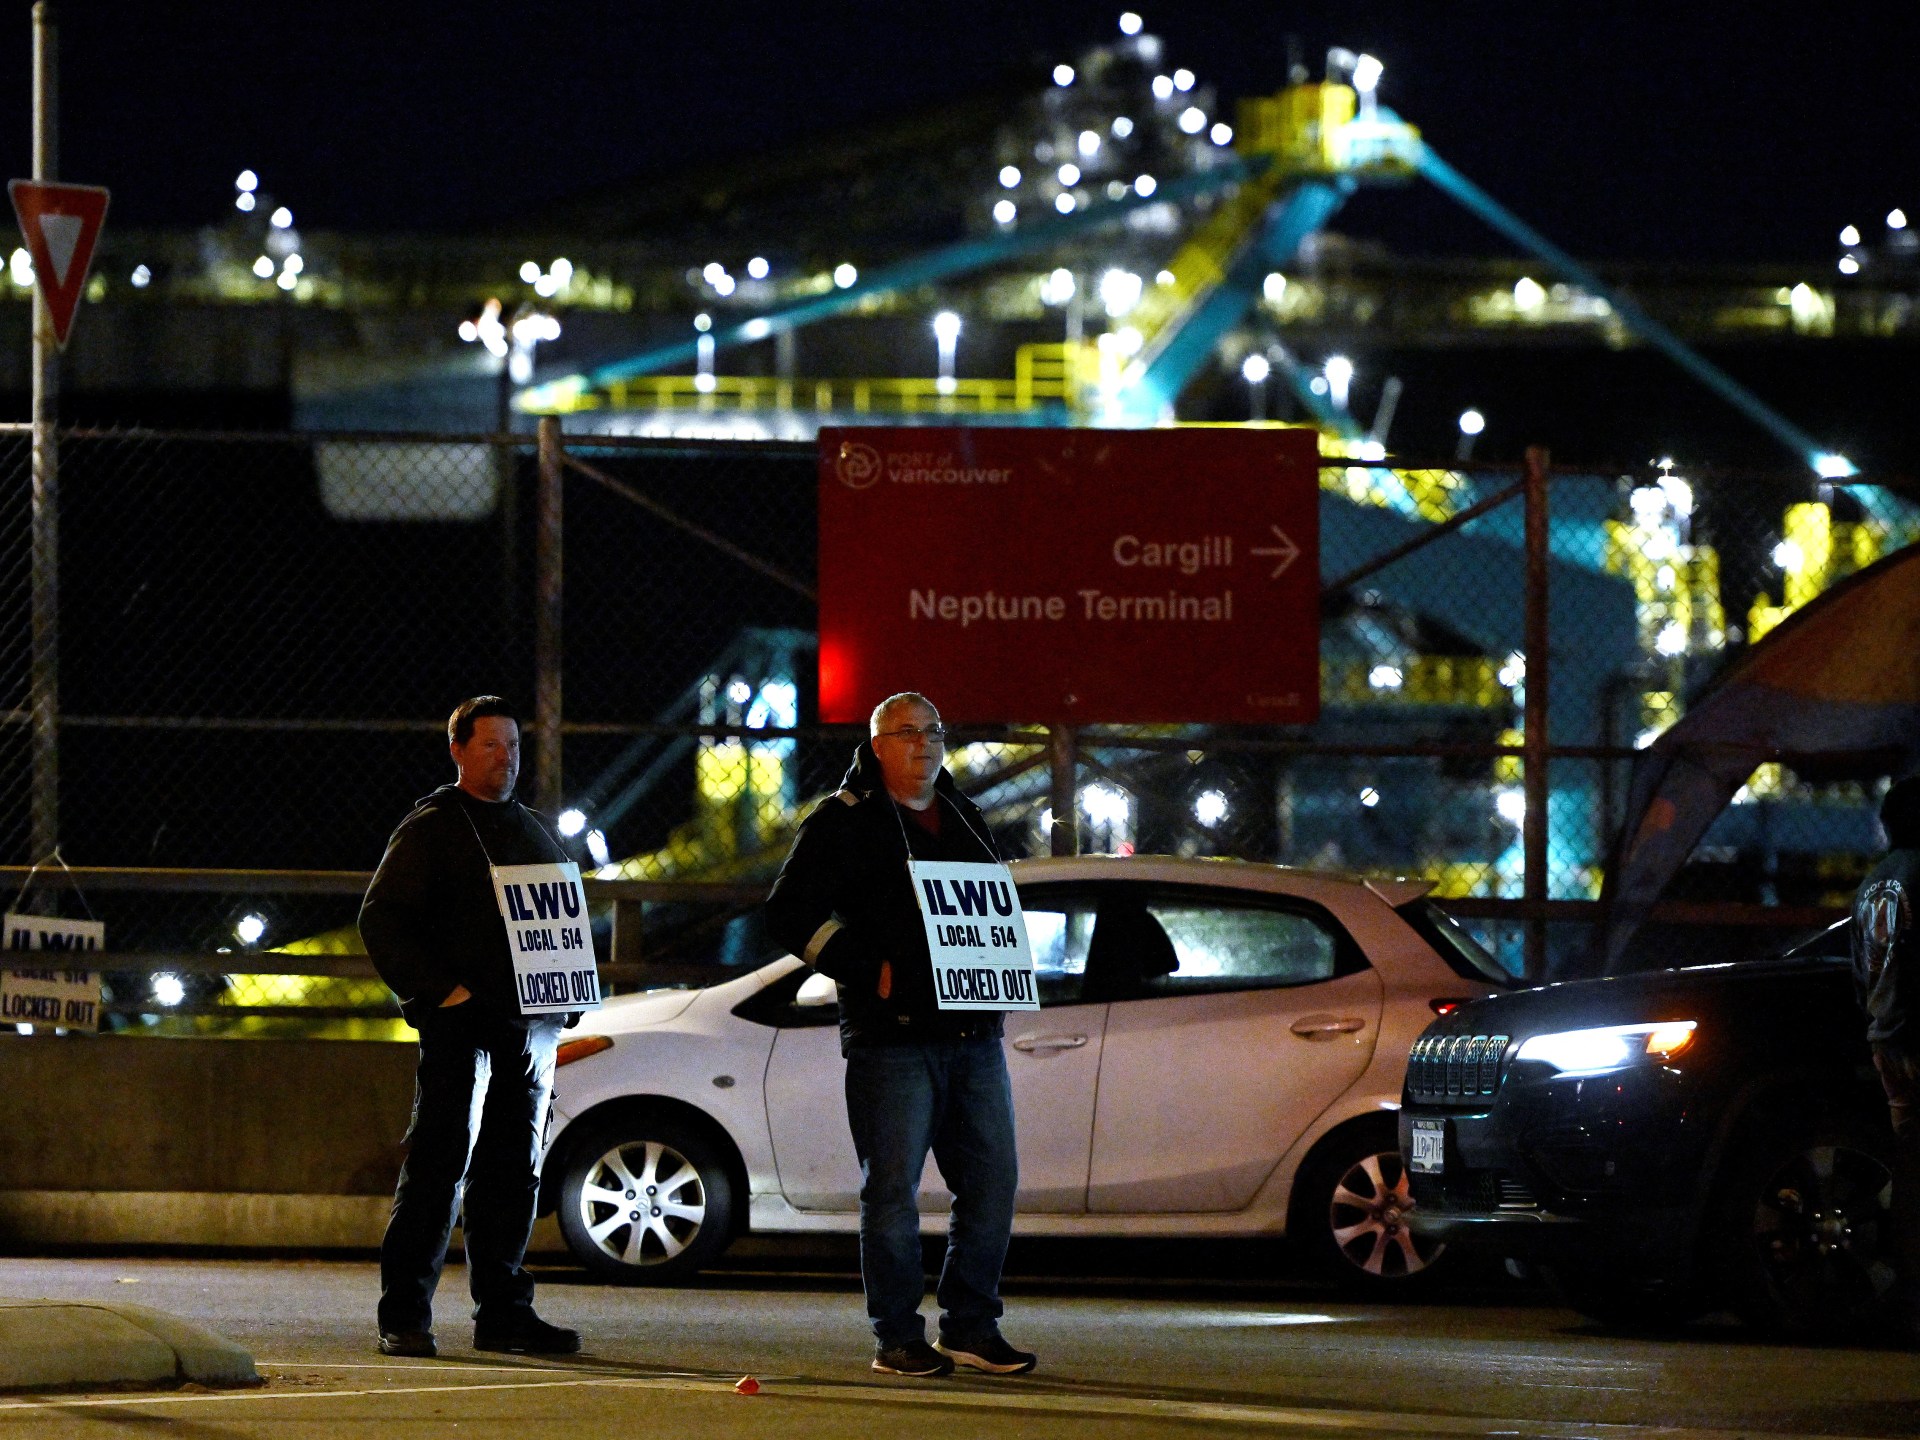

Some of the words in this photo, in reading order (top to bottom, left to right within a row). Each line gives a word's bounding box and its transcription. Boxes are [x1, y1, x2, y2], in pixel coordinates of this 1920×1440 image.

[887, 468, 1013, 484] vancouver
[1112, 533, 1233, 576] Cargill
[908, 588, 1067, 629] Neptune
[1077, 589, 1233, 622] Terminal
[504, 882, 579, 921] ILWU
[922, 879, 1013, 917] ILWU
[517, 929, 557, 951] LOCAL
[561, 927, 583, 950] 514
[937, 924, 987, 948] LOCAL
[990, 925, 1018, 949] 514
[518, 971, 569, 1004] LOCKED
[571, 969, 597, 1002] OUT
[936, 967, 1000, 1001] LOCKED
[1001, 969, 1033, 1002] OUT
[3, 994, 60, 1020] LOCKED
[66, 1000, 95, 1024] OUT
